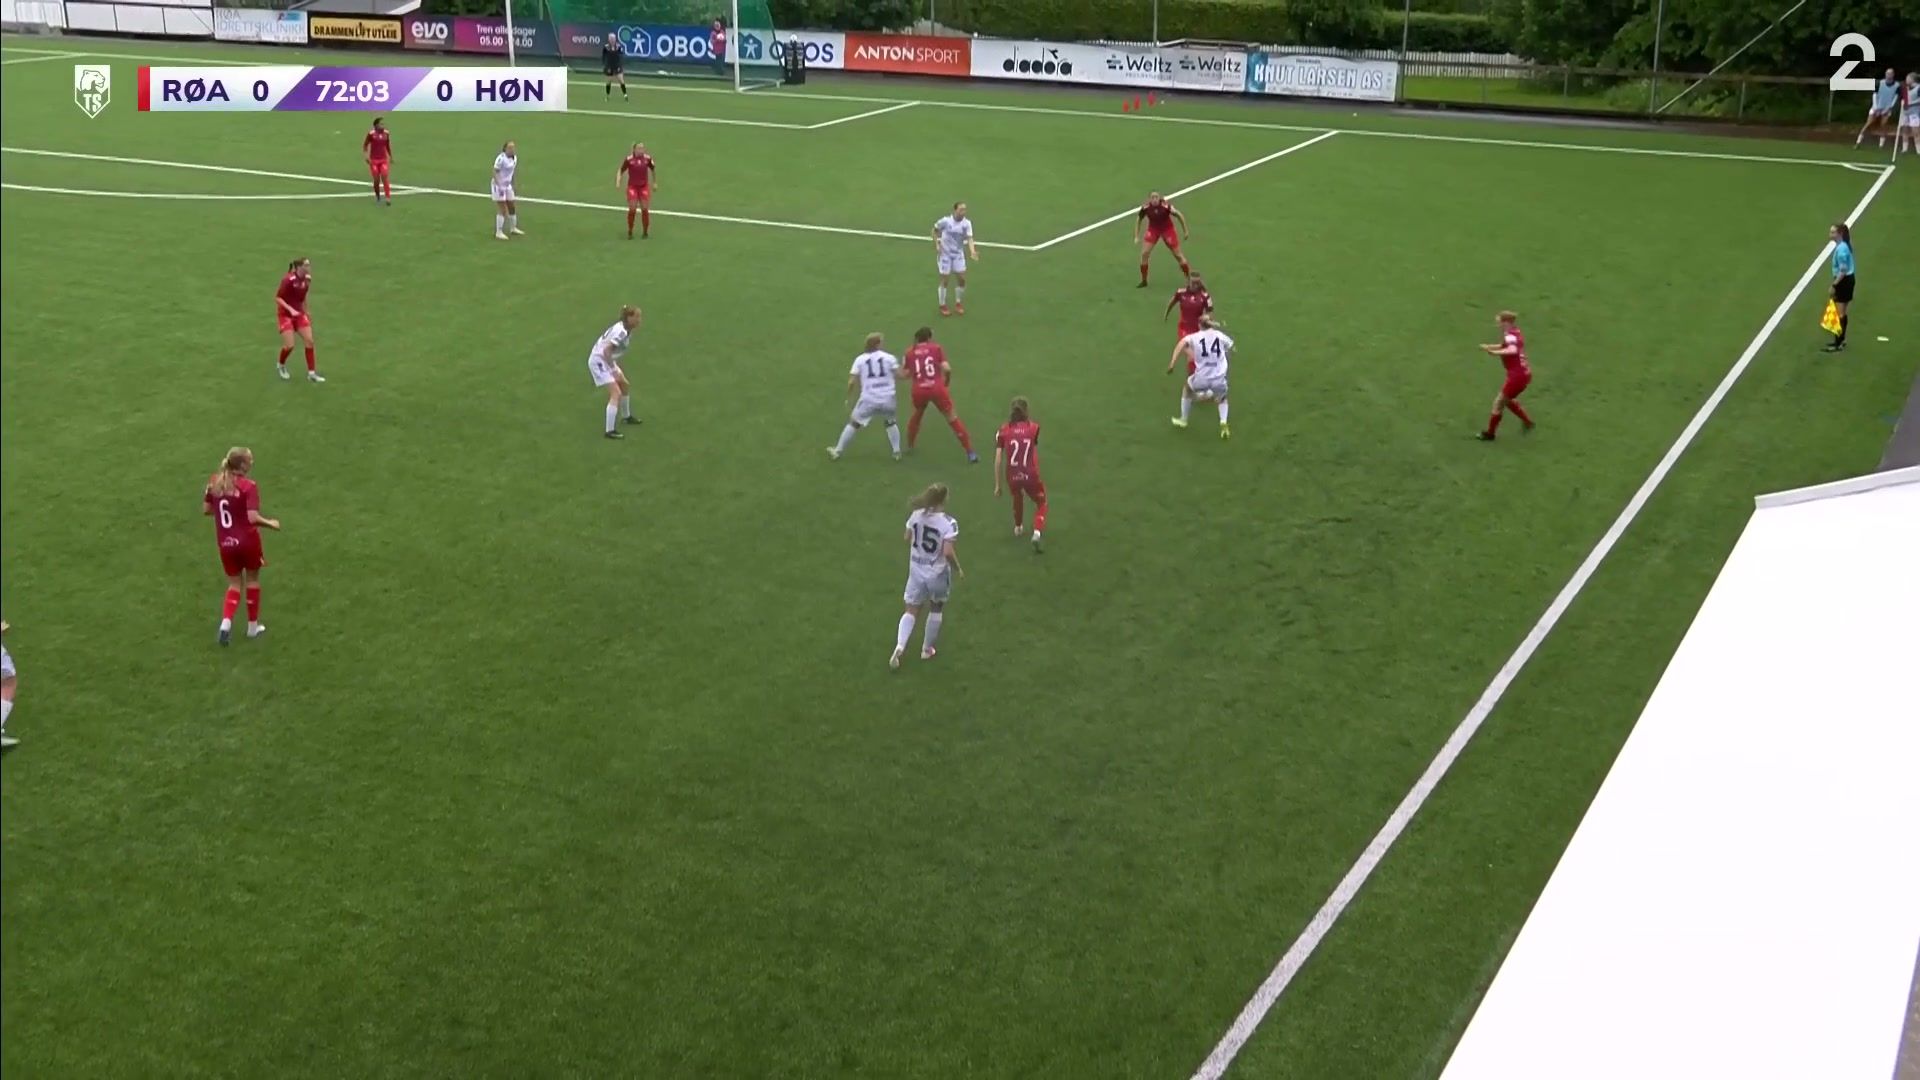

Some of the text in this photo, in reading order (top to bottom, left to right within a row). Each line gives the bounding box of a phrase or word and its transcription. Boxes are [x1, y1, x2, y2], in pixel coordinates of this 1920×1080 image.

[314, 26, 354, 37] DRAMMEN
[411, 21, 448, 39] evo
[476, 24, 493, 34] Tren
[480, 36, 503, 46] 05.00
[571, 35, 601, 44] evo.no
[1126, 55, 1172, 73] Weltz
[1198, 56, 1241, 72] Weltz
[1298, 66, 1358, 89] LARSEN
[1361, 70, 1383, 90] AS
[1199, 337, 1222, 358] 14
[865, 357, 888, 378] 11
[915, 356, 935, 378] 16
[1010, 438, 1031, 467] 27
[219, 499, 233, 528] 6
[912, 522, 941, 554] 15
